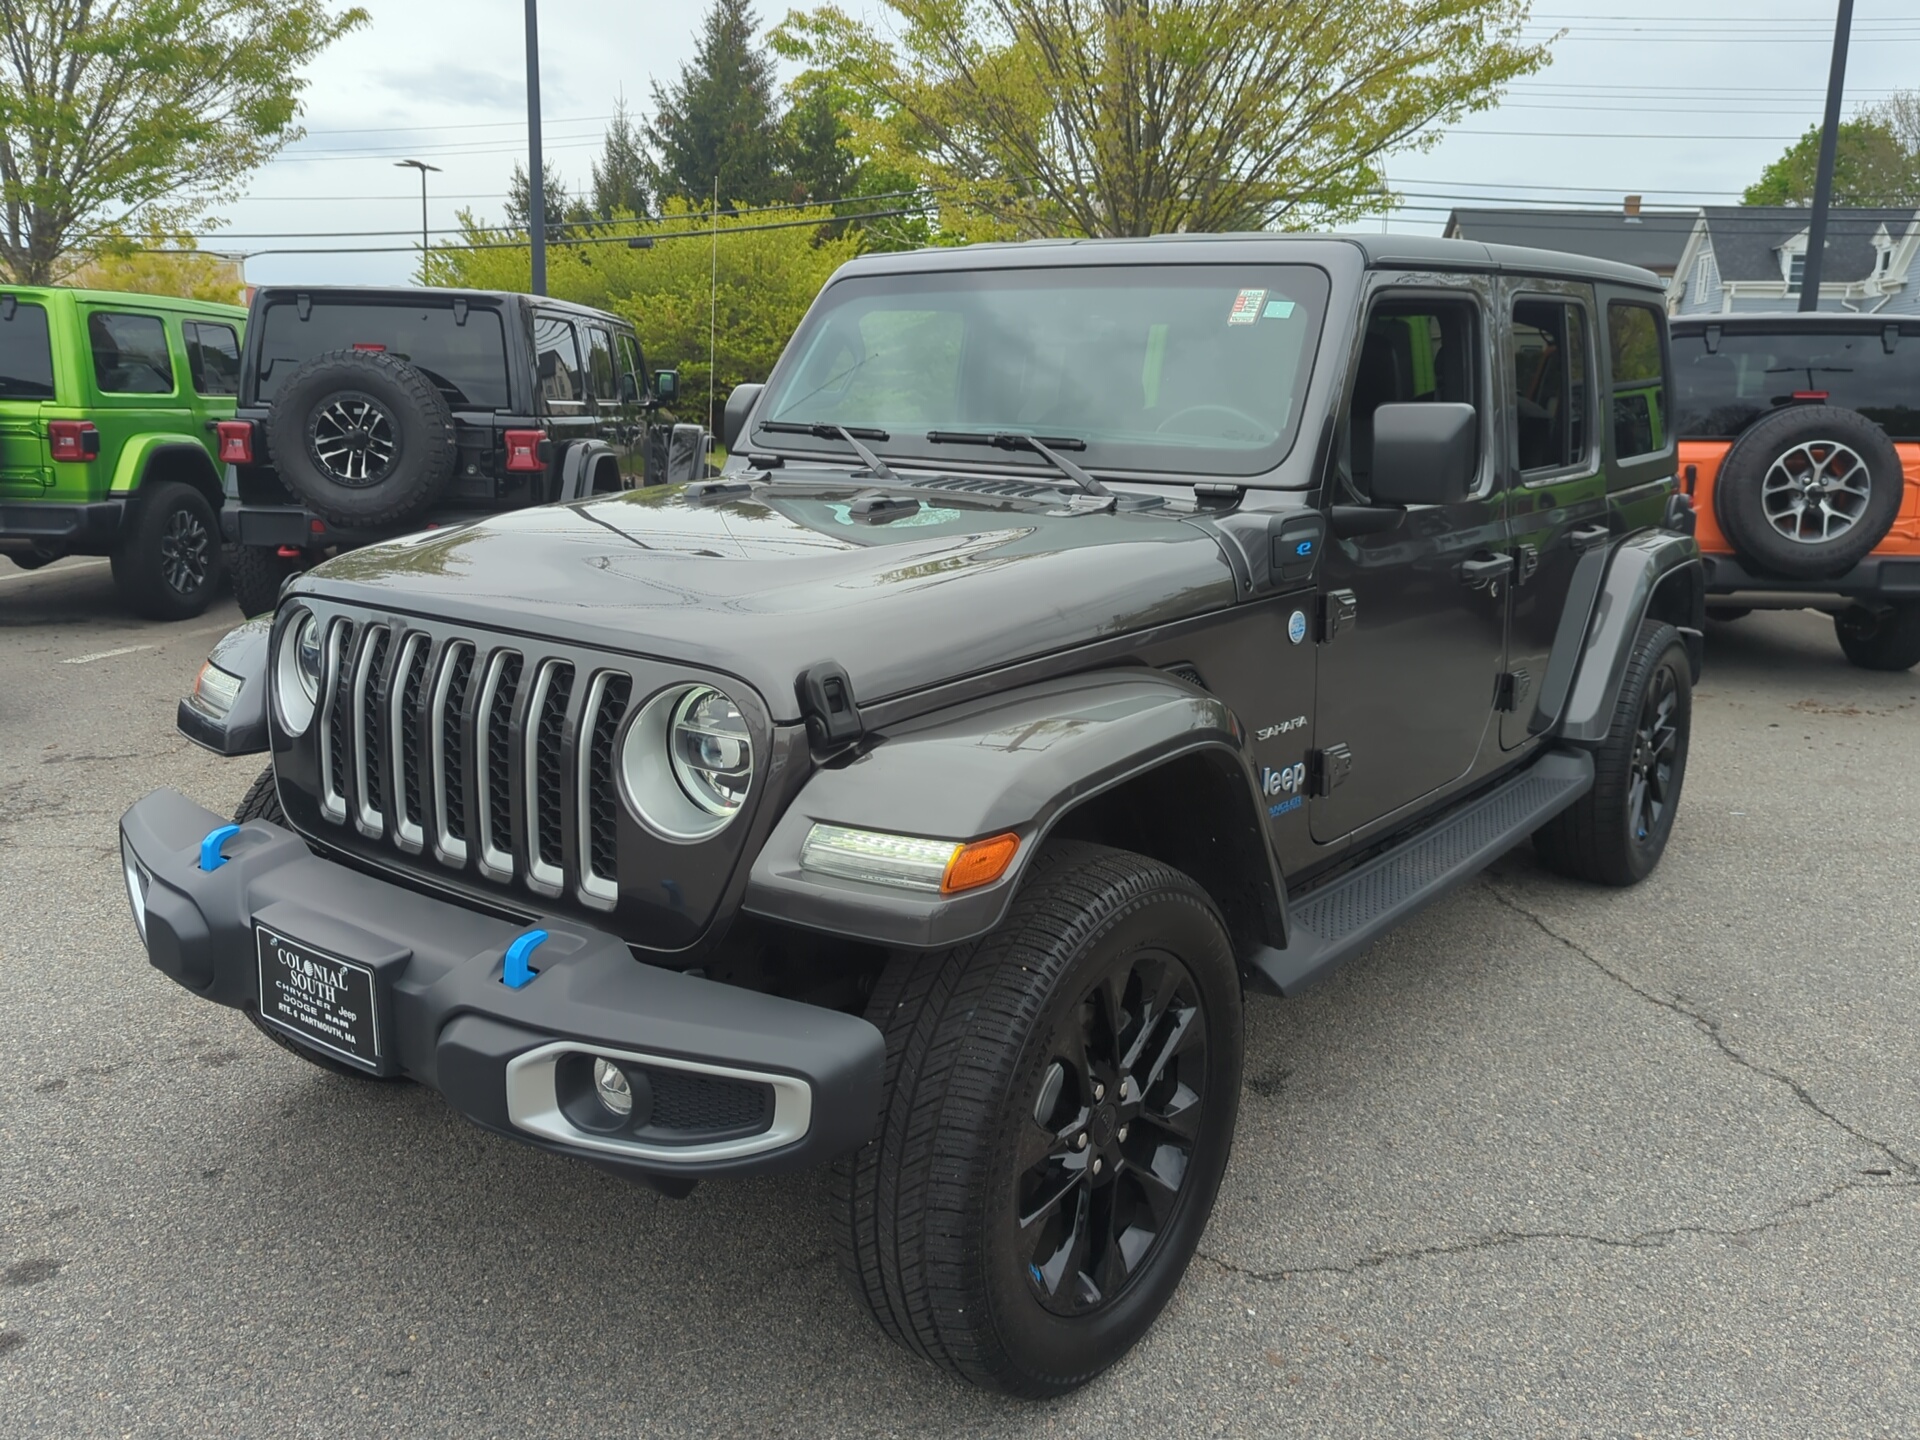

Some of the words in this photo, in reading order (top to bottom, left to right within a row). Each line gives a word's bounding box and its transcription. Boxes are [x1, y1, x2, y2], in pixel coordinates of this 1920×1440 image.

[1255, 716, 1308, 741] SAHARA
[1262, 762, 1306, 797] Jeep
[1268, 796, 1302, 815] ANGLER
[277, 948, 348, 991] COLONIAL
[290, 970, 336, 1003] SOUTH
[275, 980, 331, 1011] CHRYSLER
[338, 1006, 357, 1022] Jeep
[283, 993, 318, 1015] DODGE
[325, 1013, 349, 1029] RAM
[278, 1002, 293, 1016] RTE.
[293, 1009, 298, 1018] 6
[300, 1013, 344, 1040] DARTMOUTH,
[344, 1031, 357, 1044] MA
